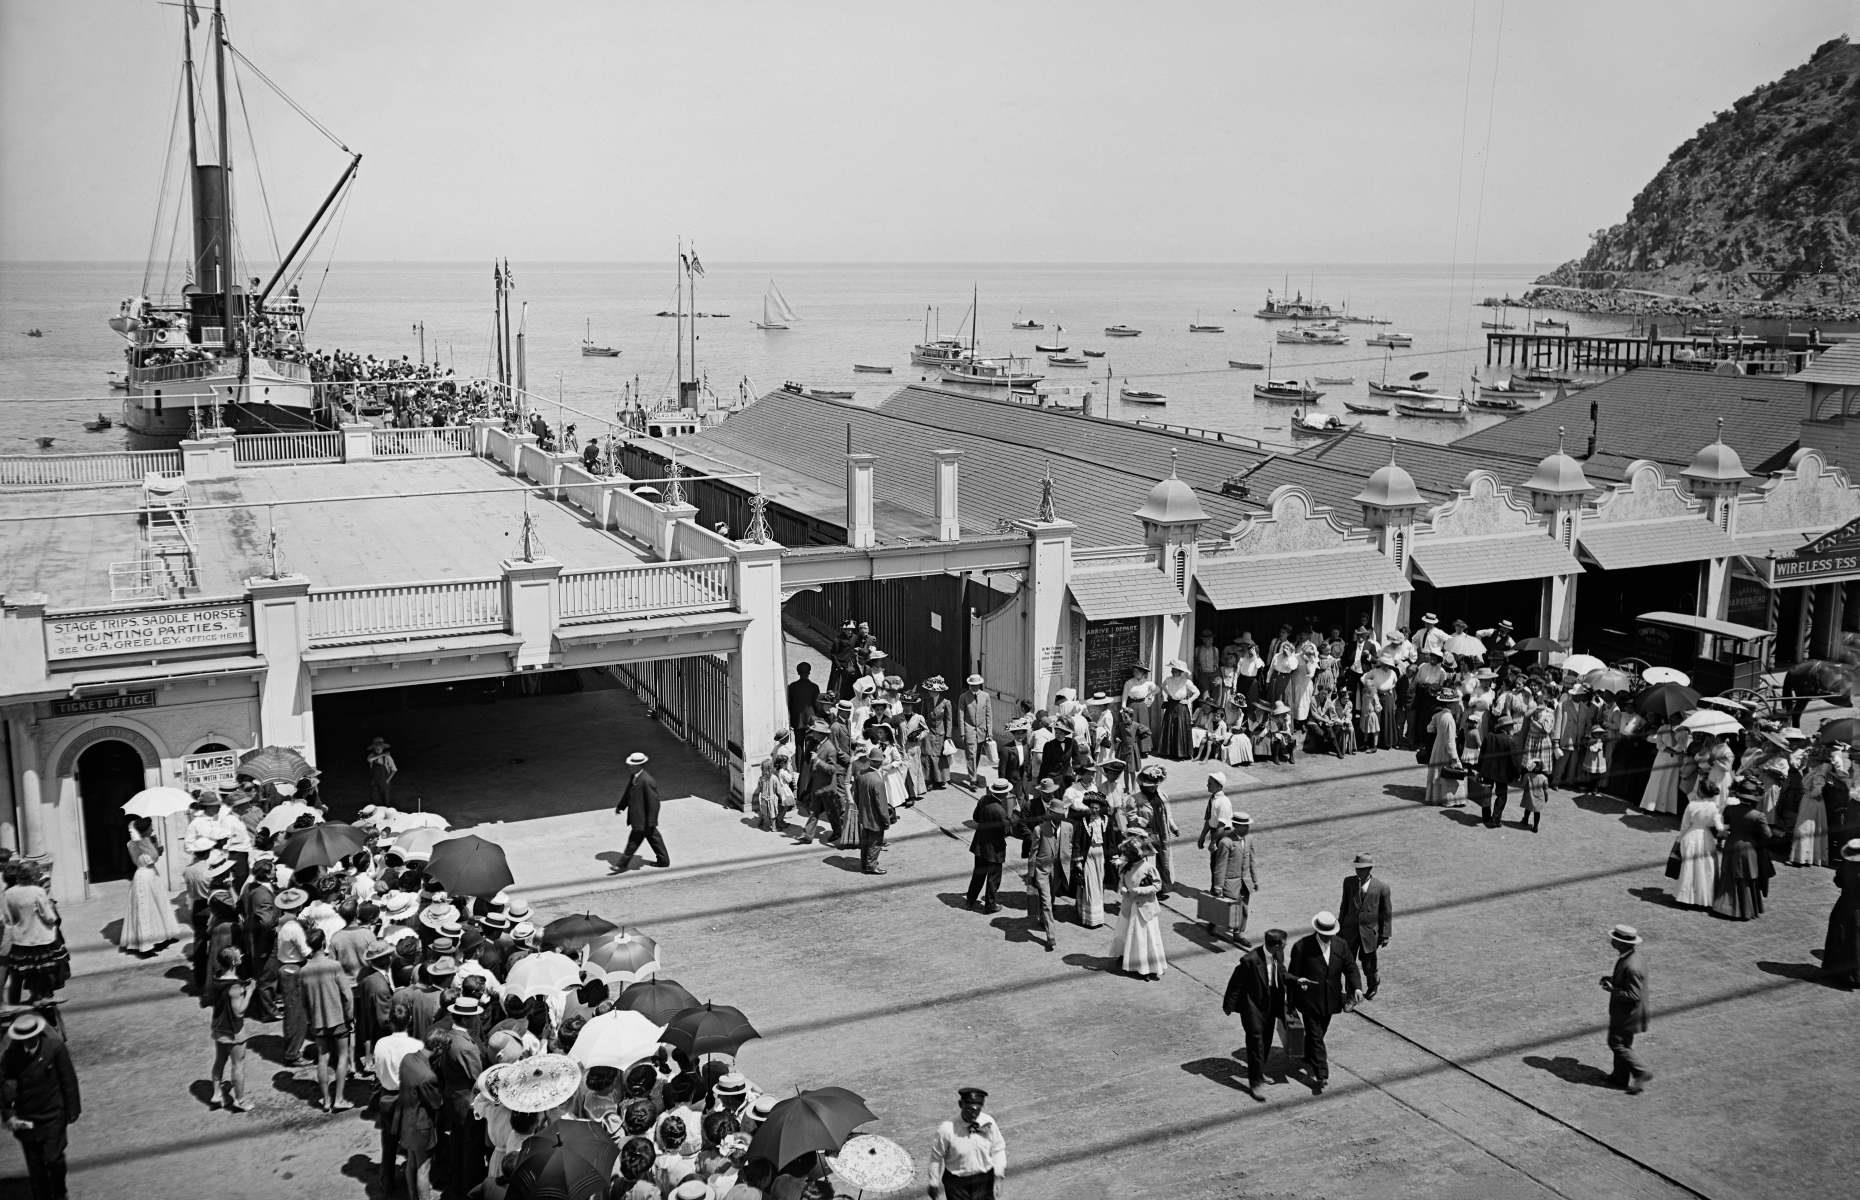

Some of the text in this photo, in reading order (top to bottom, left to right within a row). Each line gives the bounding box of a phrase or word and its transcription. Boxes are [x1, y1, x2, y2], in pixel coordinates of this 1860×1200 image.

[1776, 558, 1833, 575] WIRELESS
[54, 621, 97, 634] STAGE
[142, 613, 190, 626] SADDLE
[58, 646, 79, 655] SEE
[185, 633, 217, 643] OFFICE
[220, 631, 244, 640] HERE
[77, 628, 153, 643] HUNTING
[60, 695, 149, 713] TICKET OFFICE
[187, 756, 233, 770] TIMES
